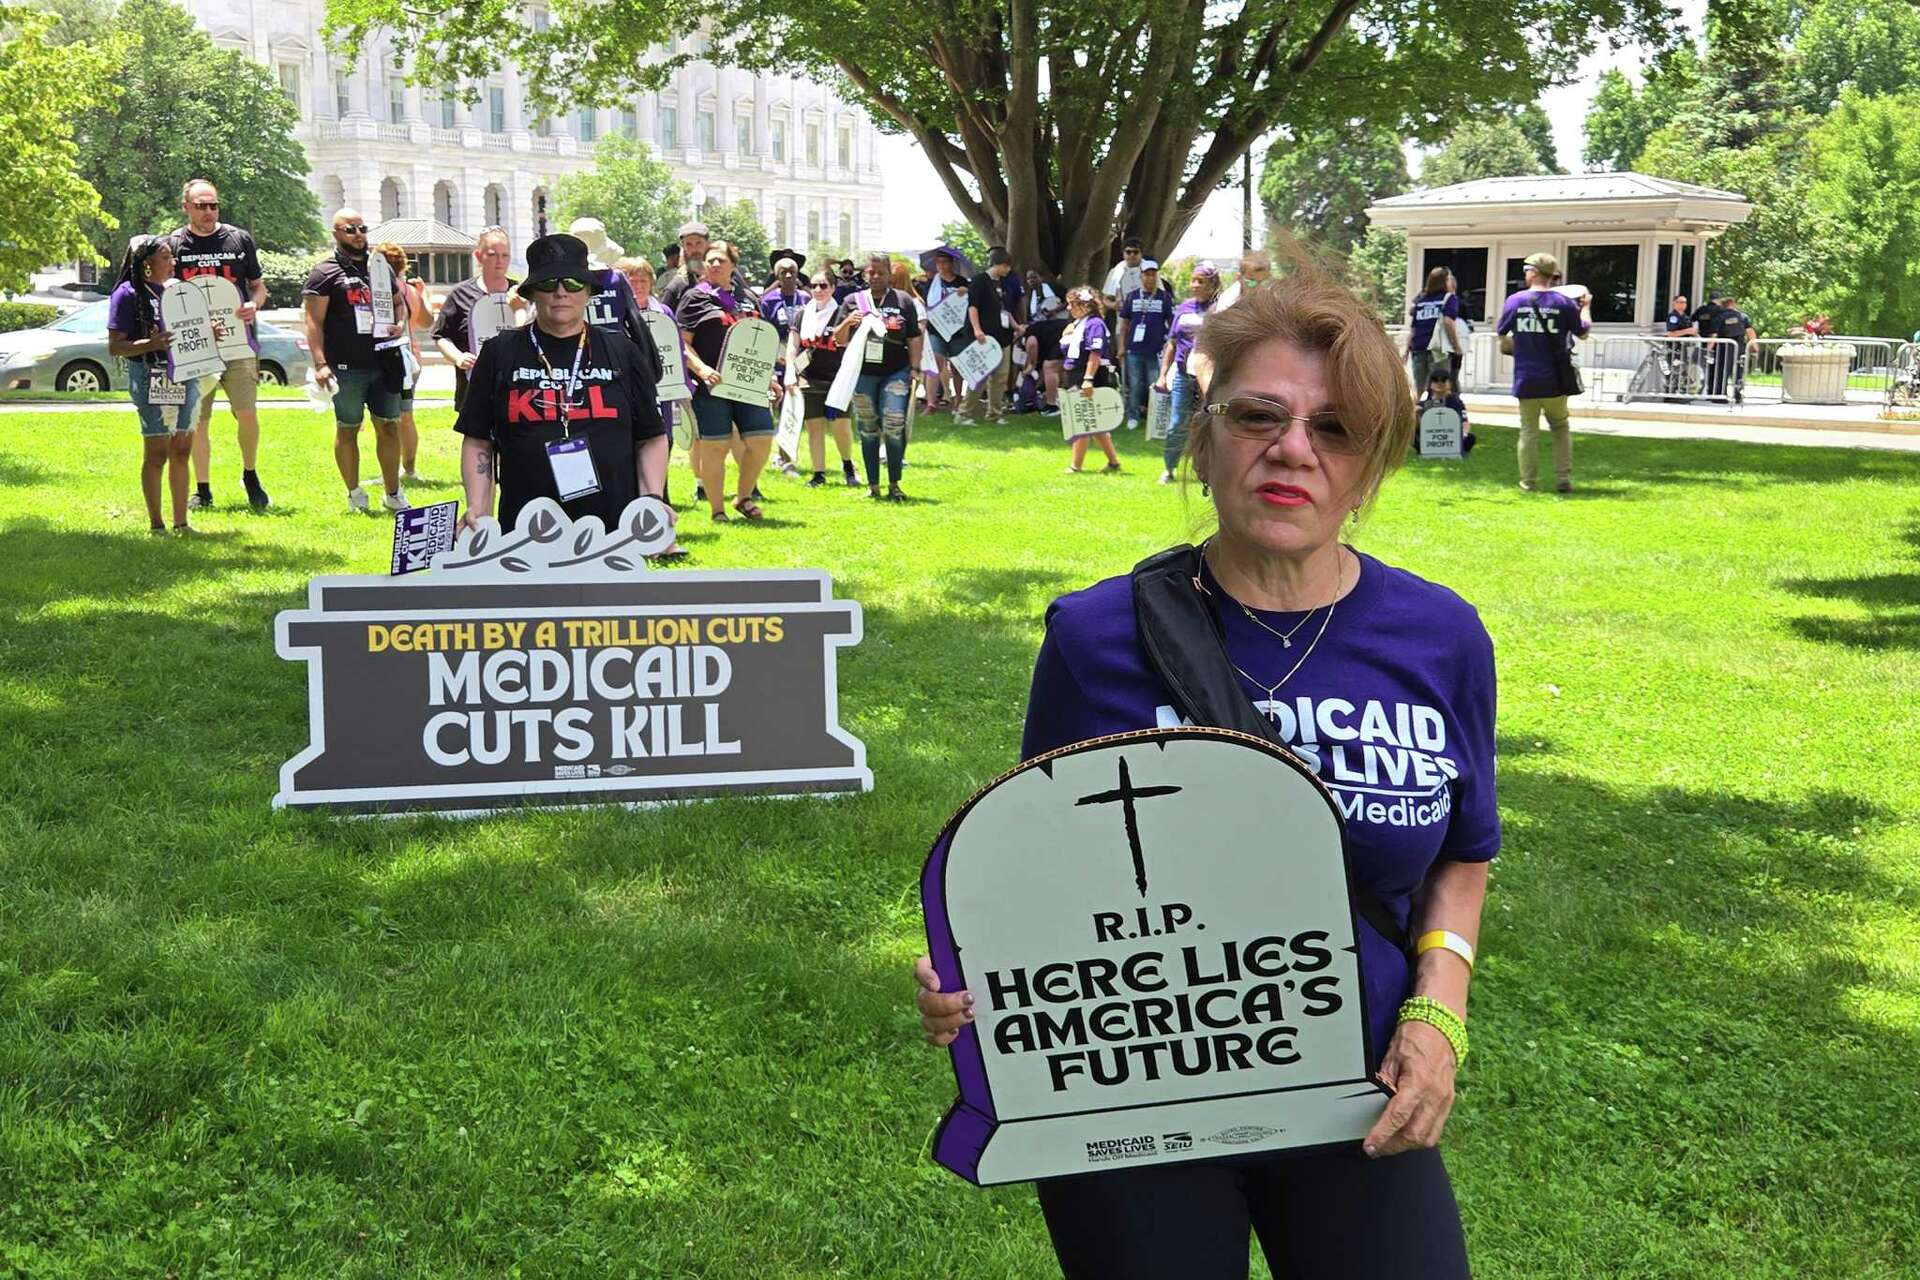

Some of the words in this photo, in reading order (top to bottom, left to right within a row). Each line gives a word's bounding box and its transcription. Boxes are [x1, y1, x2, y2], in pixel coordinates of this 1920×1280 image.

[198, 260, 221, 268] CUTS
[177, 338, 208, 353] PROFIT
[181, 327, 201, 341] FOR
[727, 353, 772, 371] SACRIFICED
[731, 362, 749, 374] FOR
[749, 366, 765, 378] THE
[736, 372, 756, 384] RICH
[508, 385, 618, 422] KILL
[401, 529, 411, 555] CUTS
[406, 507, 431, 571] KILL
[368, 622, 475, 652] DEATH
[489, 621, 528, 650] BY
[535, 621, 556, 649] A
[563, 617, 700, 648] TRILLION
[707, 616, 785, 644] CUTS
[428, 645, 733, 706] MEDICAID
[423, 706, 595, 767] CUTS
[610, 703, 742, 758] KILL
[1156, 697, 1446, 753] DICAID
[1332, 744, 1460, 786] LIVES
[1093, 903, 1206, 942] R.I.P.
[985, 951, 1168, 1011] HERE
[1183, 930, 1332, 985] LIES
[993, 976, 1343, 1055] AMERICA'S
[1047, 1026, 1302, 1092] FUTURE
[1086, 1135, 1154, 1150] MEDICAID
[1088, 1147, 1122, 1157] SAVES
[1124, 1143, 1156, 1153] LIVES
[1163, 1141, 1192, 1150] SEIU
